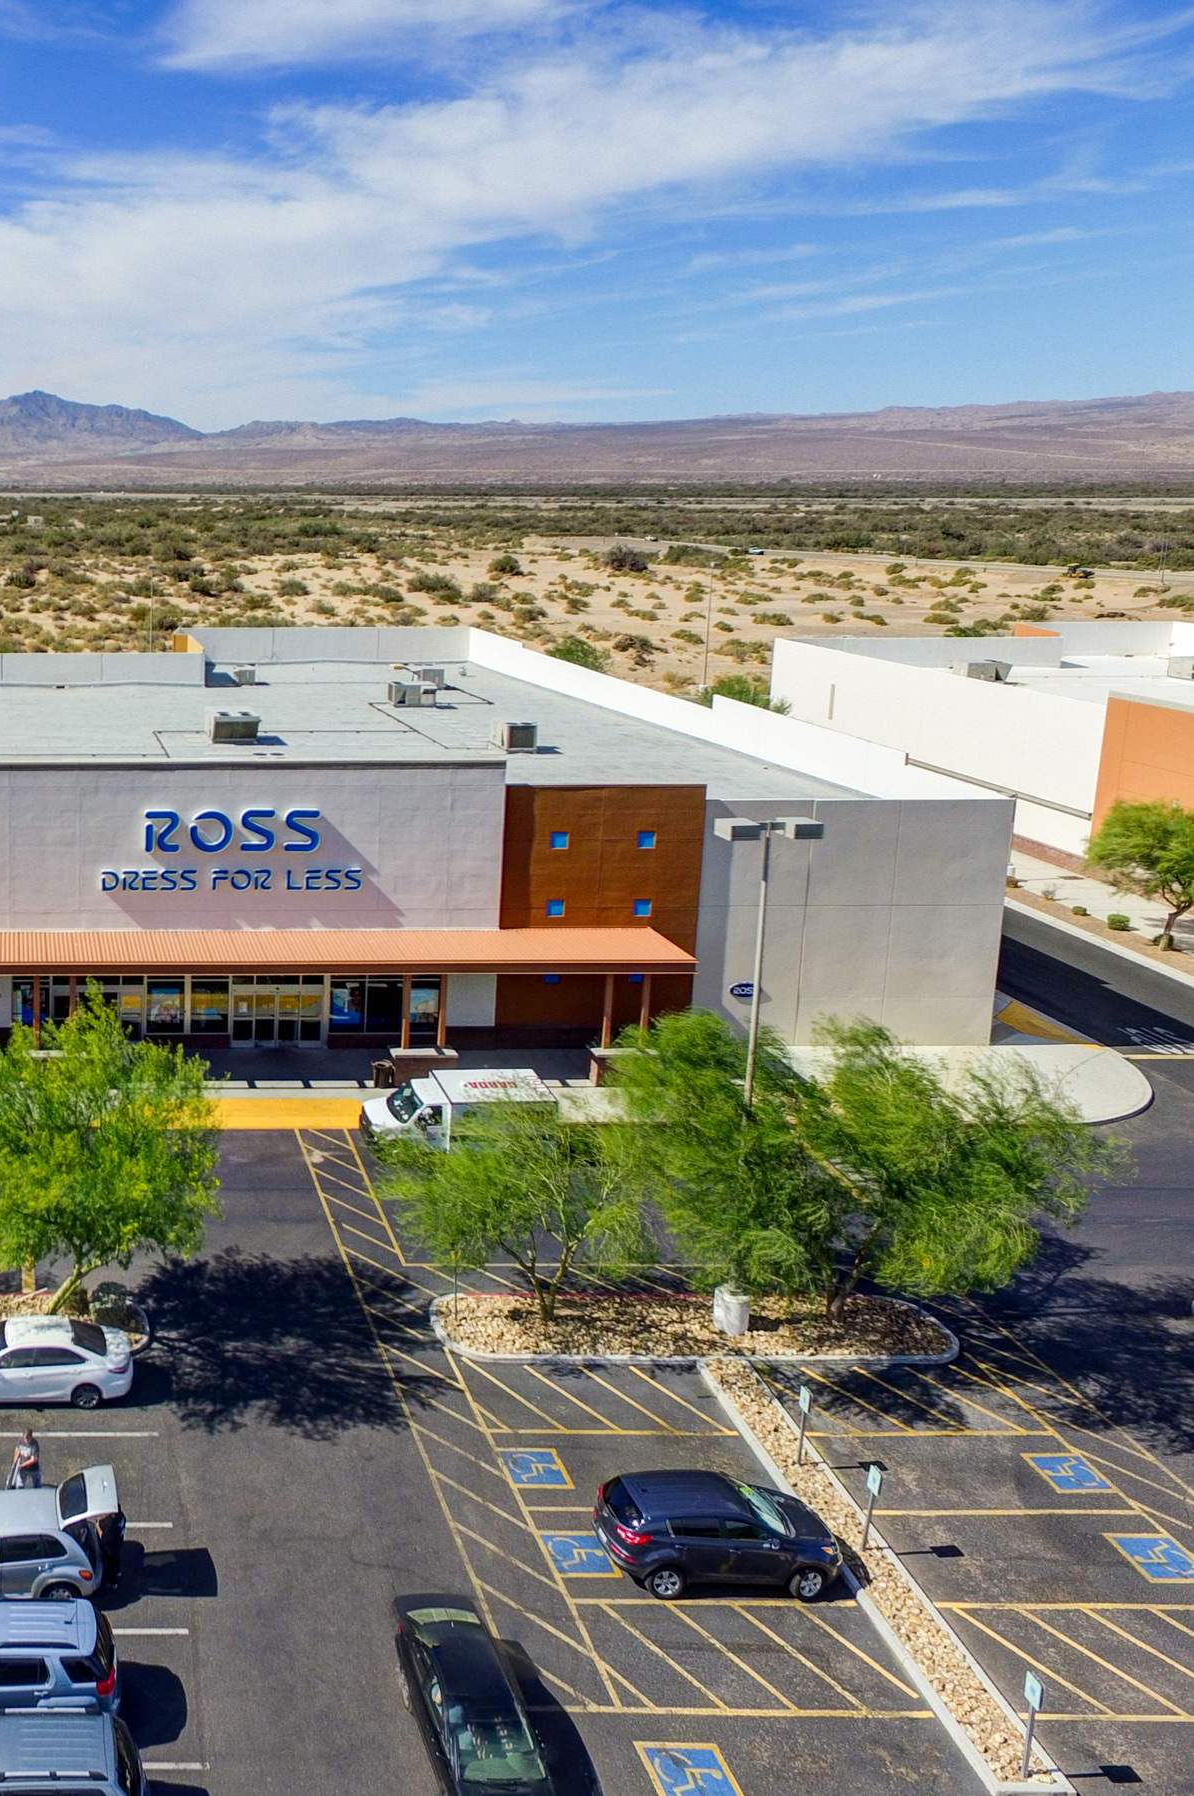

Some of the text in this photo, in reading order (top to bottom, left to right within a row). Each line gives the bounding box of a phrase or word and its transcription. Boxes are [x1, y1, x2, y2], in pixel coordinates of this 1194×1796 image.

[144, 808, 321, 853] ROSS
[101, 867, 362, 892] DRESS FOR LESS
[733, 986, 754, 994] ROS
